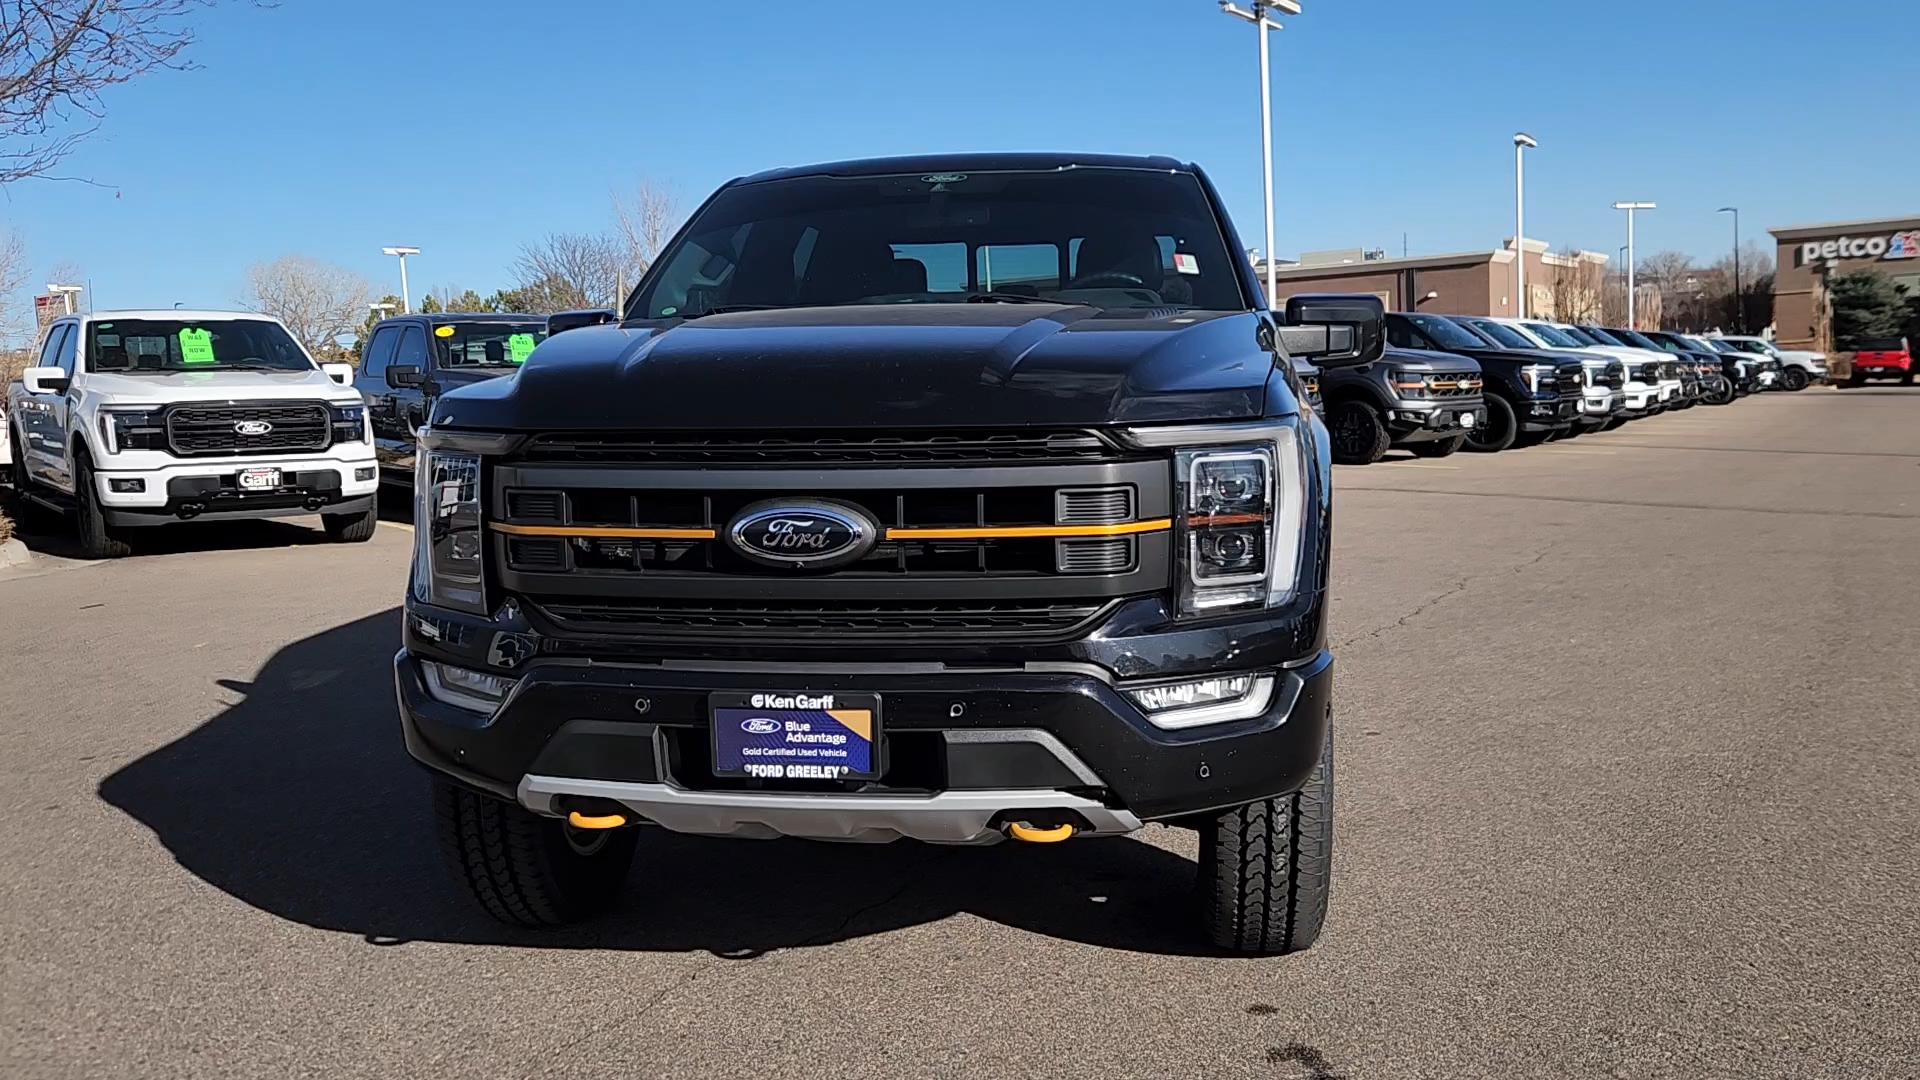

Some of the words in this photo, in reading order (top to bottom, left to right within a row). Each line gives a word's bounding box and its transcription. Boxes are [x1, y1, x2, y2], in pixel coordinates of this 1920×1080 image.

[1802, 236, 1886, 265] petco
[242, 422, 265, 432] Ford
[239, 471, 279, 487] Garff
[763, 519, 832, 548] Ford
[765, 694, 795, 708] Ken
[796, 695, 834, 709] Garff
[748, 721, 773, 731] Ford
[785, 721, 811, 731] Blue
[785, 732, 846, 745] Advantage
[743, 747, 762, 756] Gold
[763, 748, 796, 756] Certified
[797, 748, 817, 757] Used
[819, 749, 847, 757] Vehicle
[752, 765, 784, 778] FORD
[787, 765, 840, 779] GREELEY
